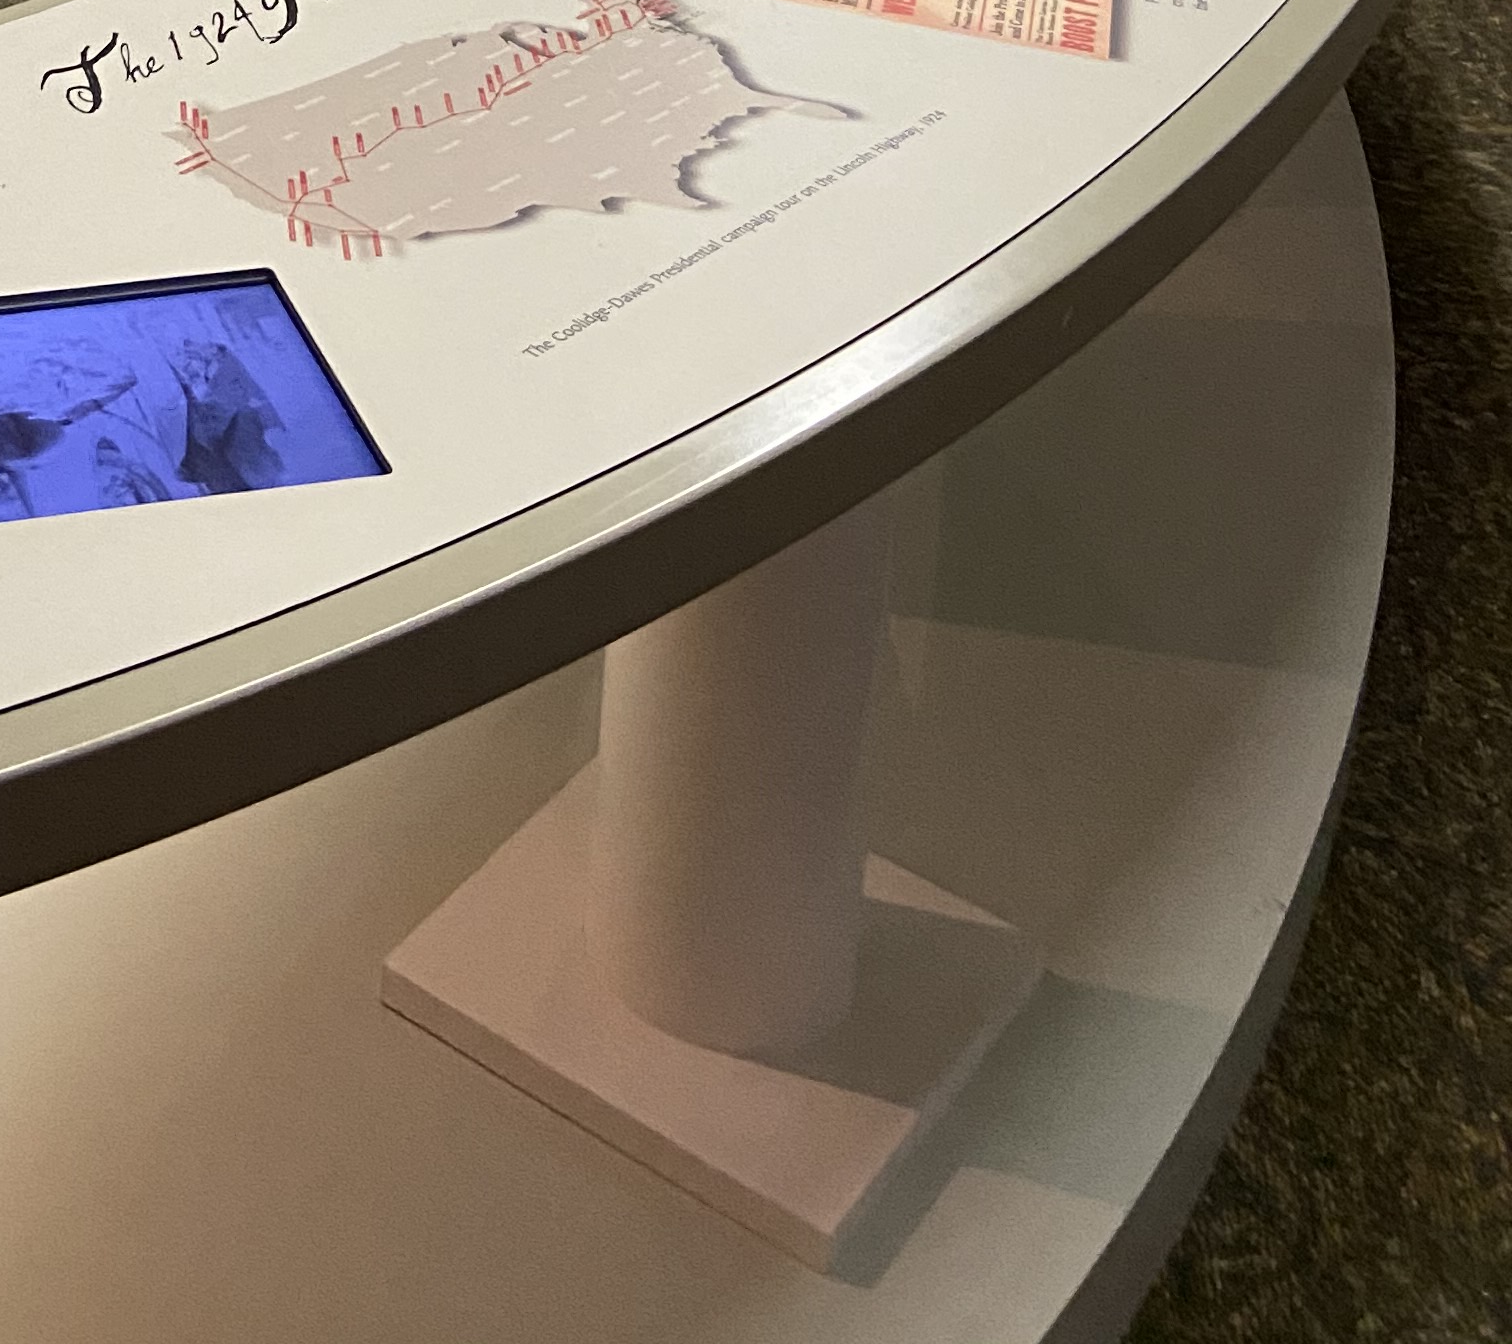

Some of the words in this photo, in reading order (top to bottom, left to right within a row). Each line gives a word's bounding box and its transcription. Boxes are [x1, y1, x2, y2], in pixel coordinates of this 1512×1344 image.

[40, 32, 165, 113] The
[168, 0, 265, 66] 1924
[1060, 7, 1098, 52] BOOST
[522, 339, 555, 358] The
[552, 281, 655, 341] Coolidge-Dawes
[649, 240, 723, 283] Presidential
[721, 209, 778, 243] campaign
[774, 194, 802, 211] tour
[801, 185, 818, 196] on
[815, 174, 837, 187] the
[833, 152, 878, 176] Lincoln
[871, 125, 924, 154] Highway,
[920, 109, 947, 127] 1924
